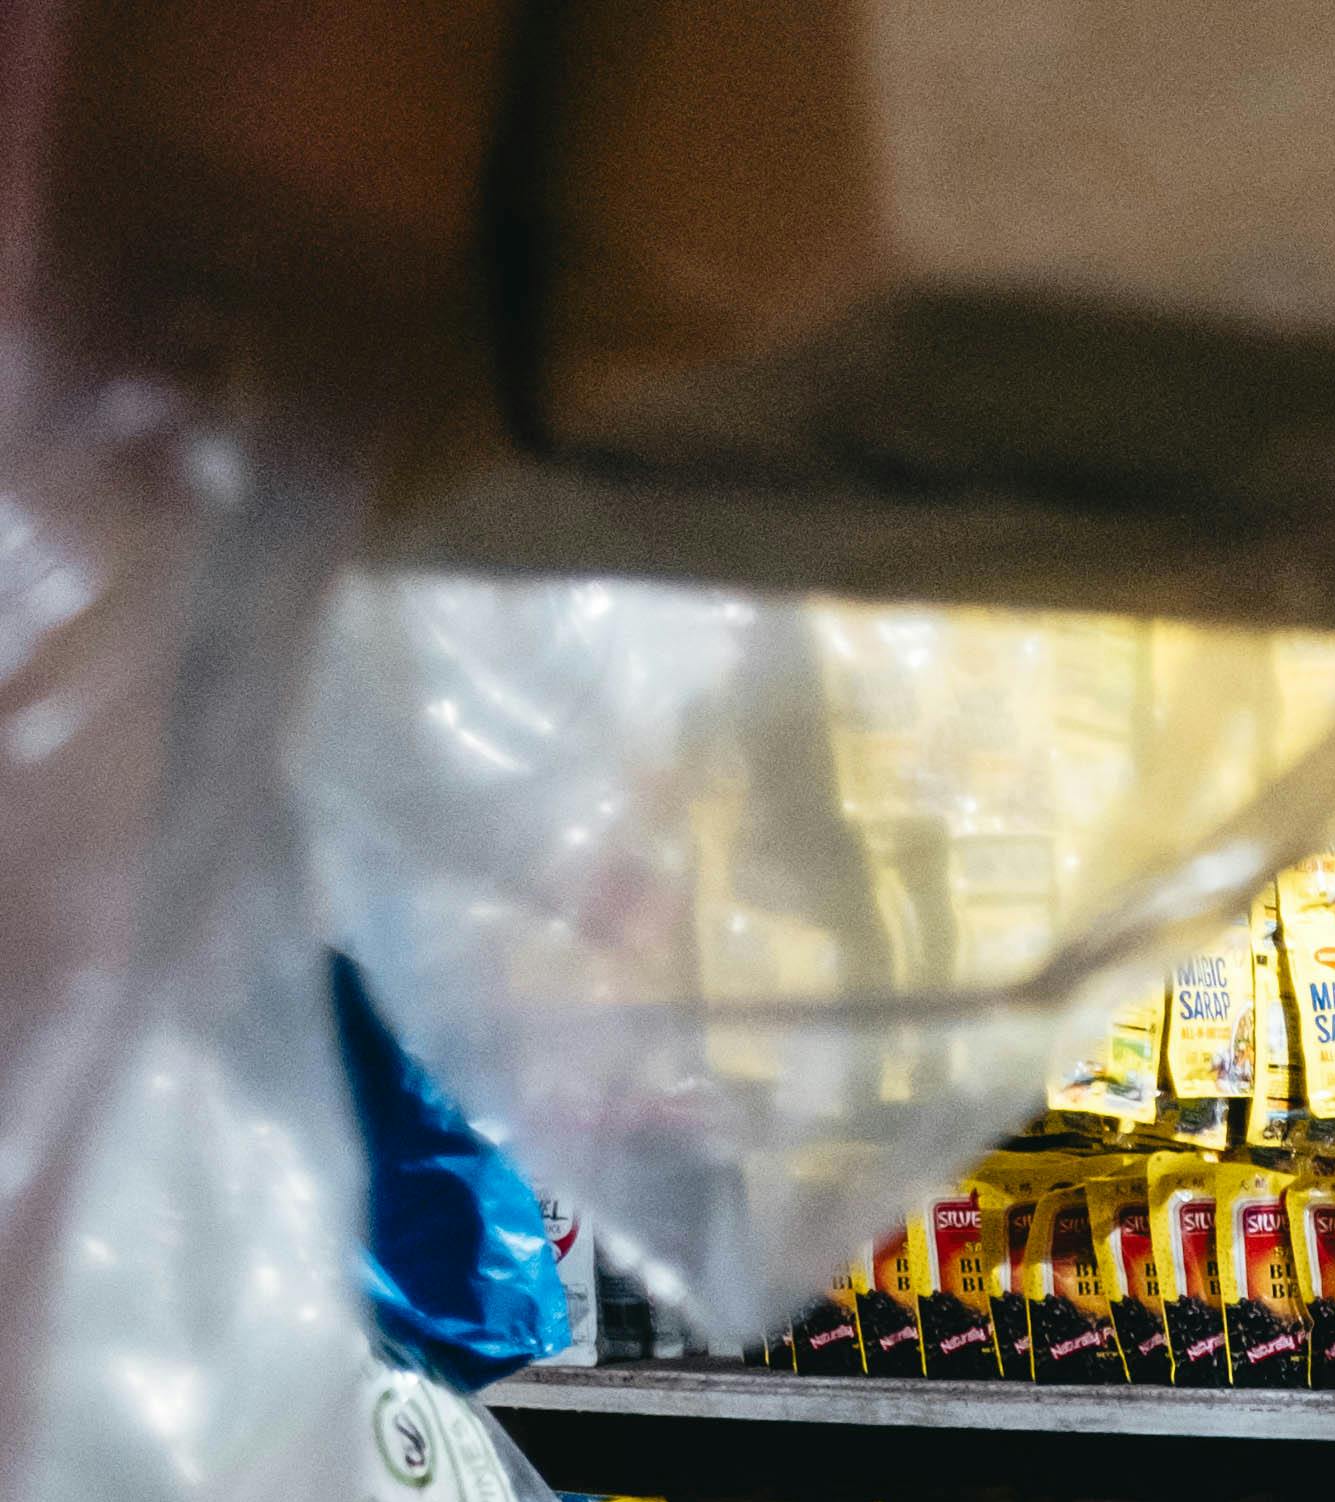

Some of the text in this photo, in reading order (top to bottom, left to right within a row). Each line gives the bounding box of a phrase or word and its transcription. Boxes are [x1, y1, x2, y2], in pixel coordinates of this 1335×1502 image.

[1178, 957, 1227, 988] MAGIC
[1180, 989, 1231, 1021] SARAP
[938, 1210, 982, 1231] SILVE
[1248, 1213, 1284, 1234] SILV
